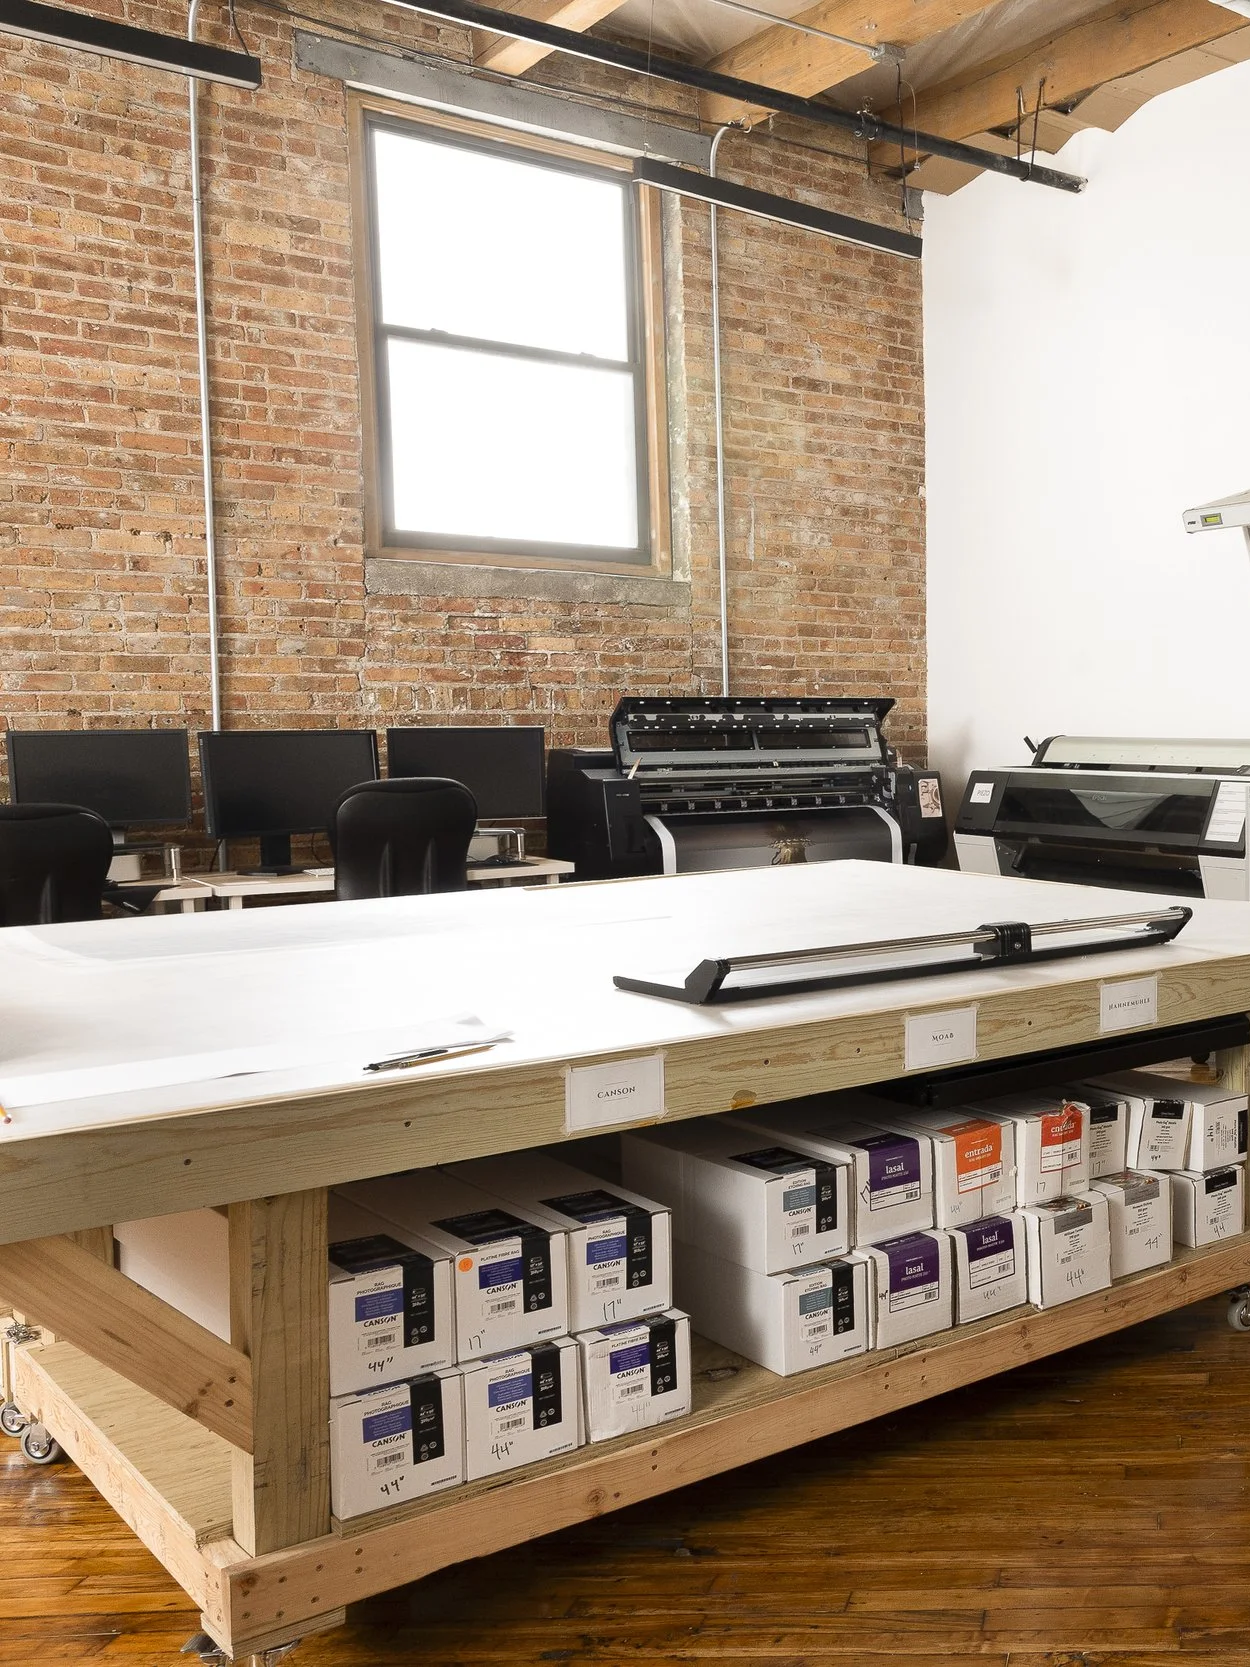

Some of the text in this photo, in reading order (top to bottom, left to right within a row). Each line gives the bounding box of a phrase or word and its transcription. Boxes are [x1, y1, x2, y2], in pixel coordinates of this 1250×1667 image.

[931, 1032, 955, 1042] MOAB
[597, 1086, 636, 1099] CANSON
[964, 1144, 993, 1159] entrada
[886, 1162, 904, 1174] lasal
[1036, 1181, 1046, 1194] 17
[788, 1206, 812, 1217] CANSON
[588, 1230, 625, 1241] PHOTOGRAPHIQUE
[1214, 1222, 1226, 1238] 44
[982, 1230, 998, 1244] lasal
[480, 1254, 498, 1262] PLATINE
[593, 1260, 621, 1271] CANSON
[906, 1262, 924, 1276] lasal
[356, 1282, 402, 1295] PHOTOGRAPHIQUE
[486, 1282, 518, 1295] CANSON
[603, 1298, 622, 1322] 17"
[805, 1309, 829, 1320] CANSON
[364, 1315, 398, 1328] CANSON
[468, 1330, 486, 1350] 17"
[368, 1356, 394, 1372] 44"
[489, 1368, 530, 1383] PHOTOGRAPHIQUE
[616, 1367, 645, 1380] CANSON
[364, 1400, 409, 1416] PHOTOGRAPHIQUE
[496, 1400, 527, 1413] CANSON
[372, 1433, 406, 1448] CANSON
[491, 1441, 514, 1460] 44"
[381, 1476, 405, 1496] 44"
